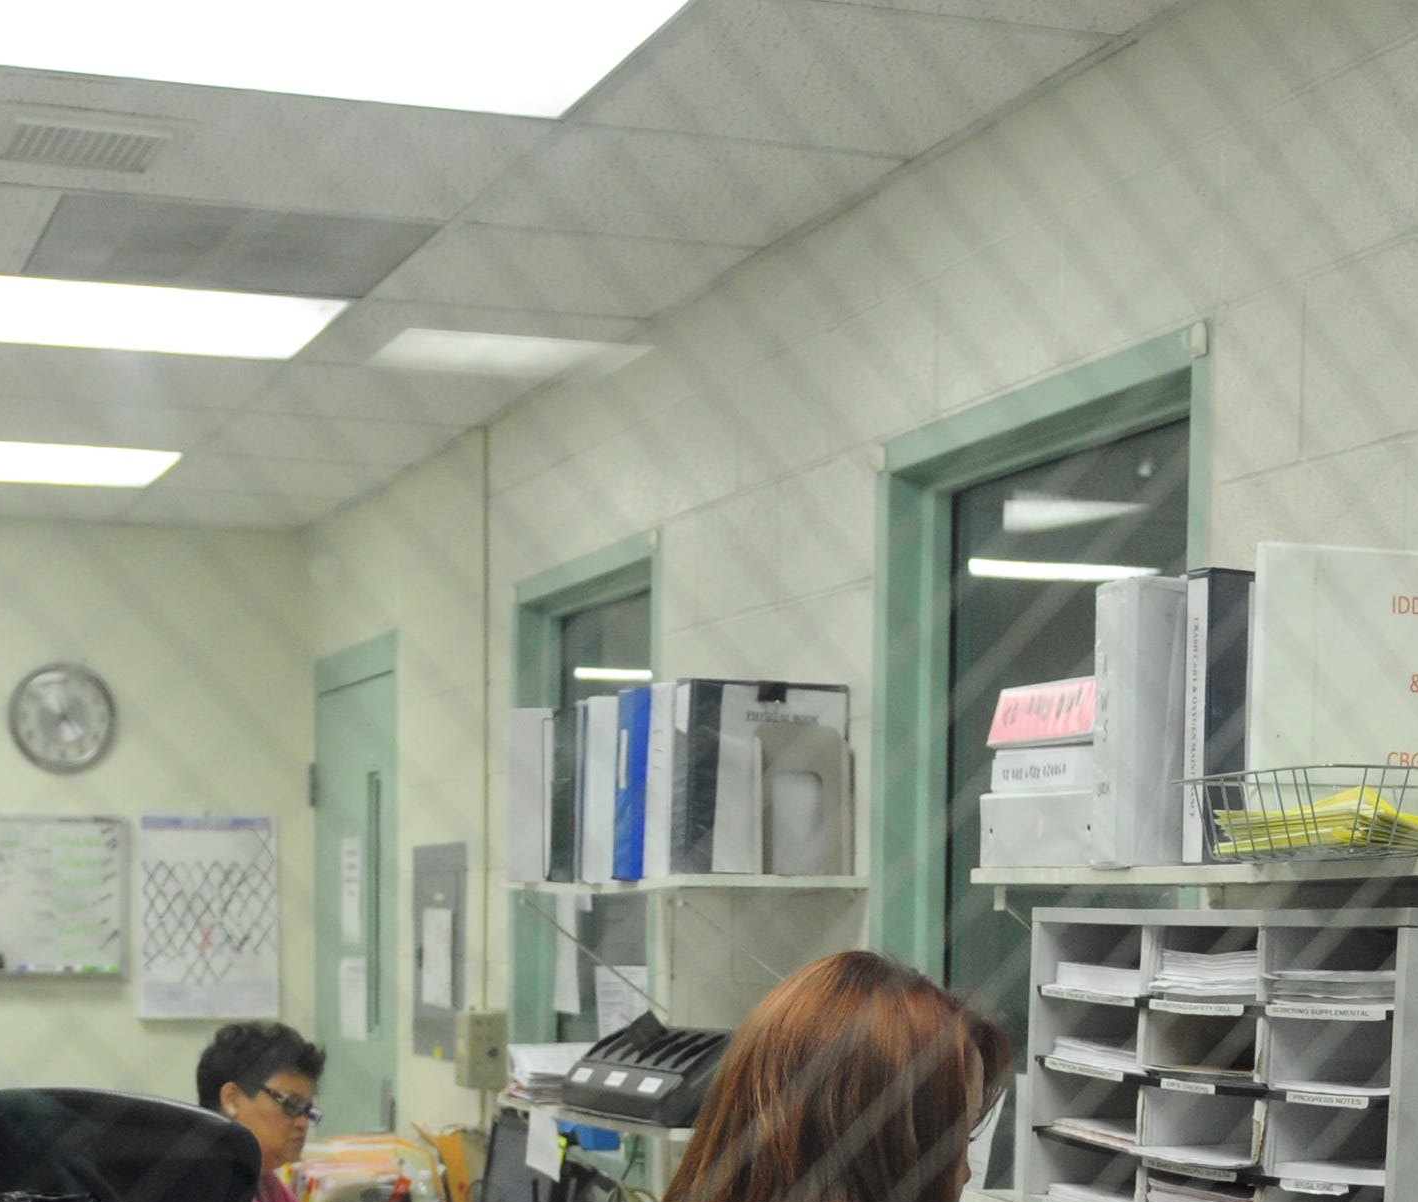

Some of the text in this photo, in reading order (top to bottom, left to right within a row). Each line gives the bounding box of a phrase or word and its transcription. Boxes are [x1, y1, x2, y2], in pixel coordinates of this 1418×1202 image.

[1189, 742, 1197, 817] MAINTNANCE
[1272, 1006, 1370, 1017] SOBERING SUPPLEMENTAL
[1292, 1093, 1362, 1106] PROGRESS NOTES
